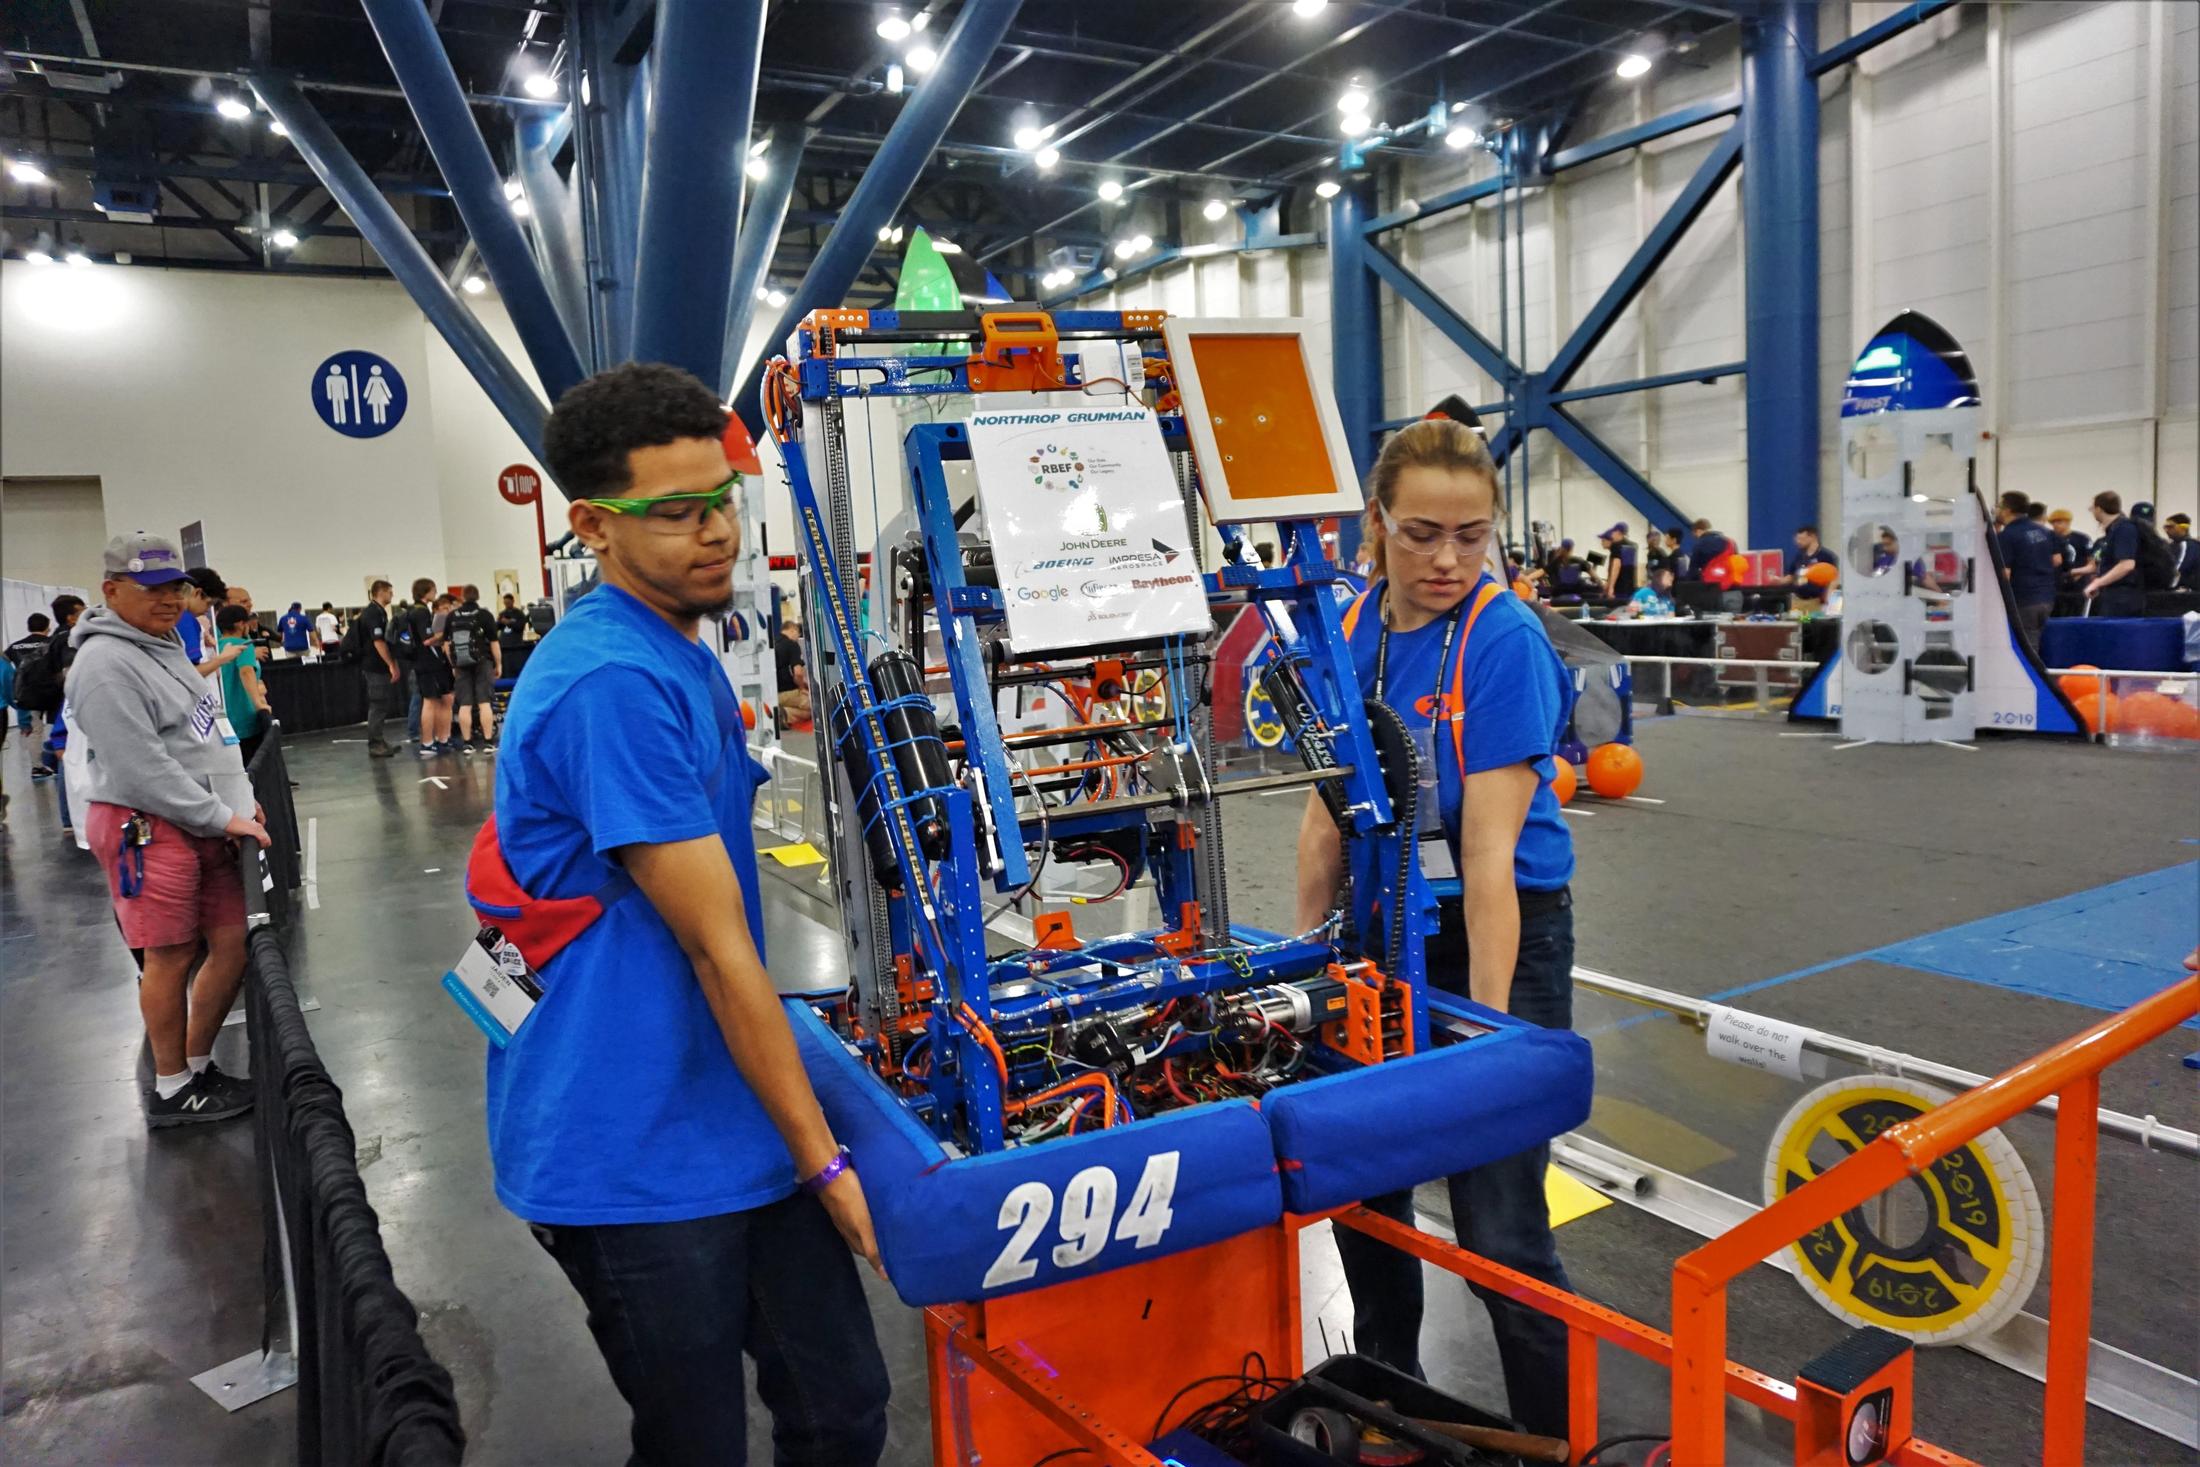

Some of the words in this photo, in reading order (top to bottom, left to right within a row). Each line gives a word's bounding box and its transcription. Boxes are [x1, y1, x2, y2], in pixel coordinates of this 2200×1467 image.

[973, 414, 1061, 426] NORTHROP
[1067, 411, 1146, 422] GRUMMAN
[1041, 462, 1072, 475] RBEF
[1060, 541, 1090, 551] JOHN
[1091, 538, 1127, 549] DEERE
[1033, 557, 1095, 570] BOEING
[1131, 575, 1194, 591] Raytheon
[1018, 584, 1069, 601] Google
[1993, 712, 2034, 726] 2019
[1724, 1013, 1755, 1032] Please
[1757, 1025, 1770, 1037] do
[1771, 1032, 1789, 1043] not
[1719, 1032, 1740, 1045] walk
[1742, 1041, 1765, 1053] over
[1768, 1048, 1787, 1061] the
[982, 1150, 1181, 1290] 294
